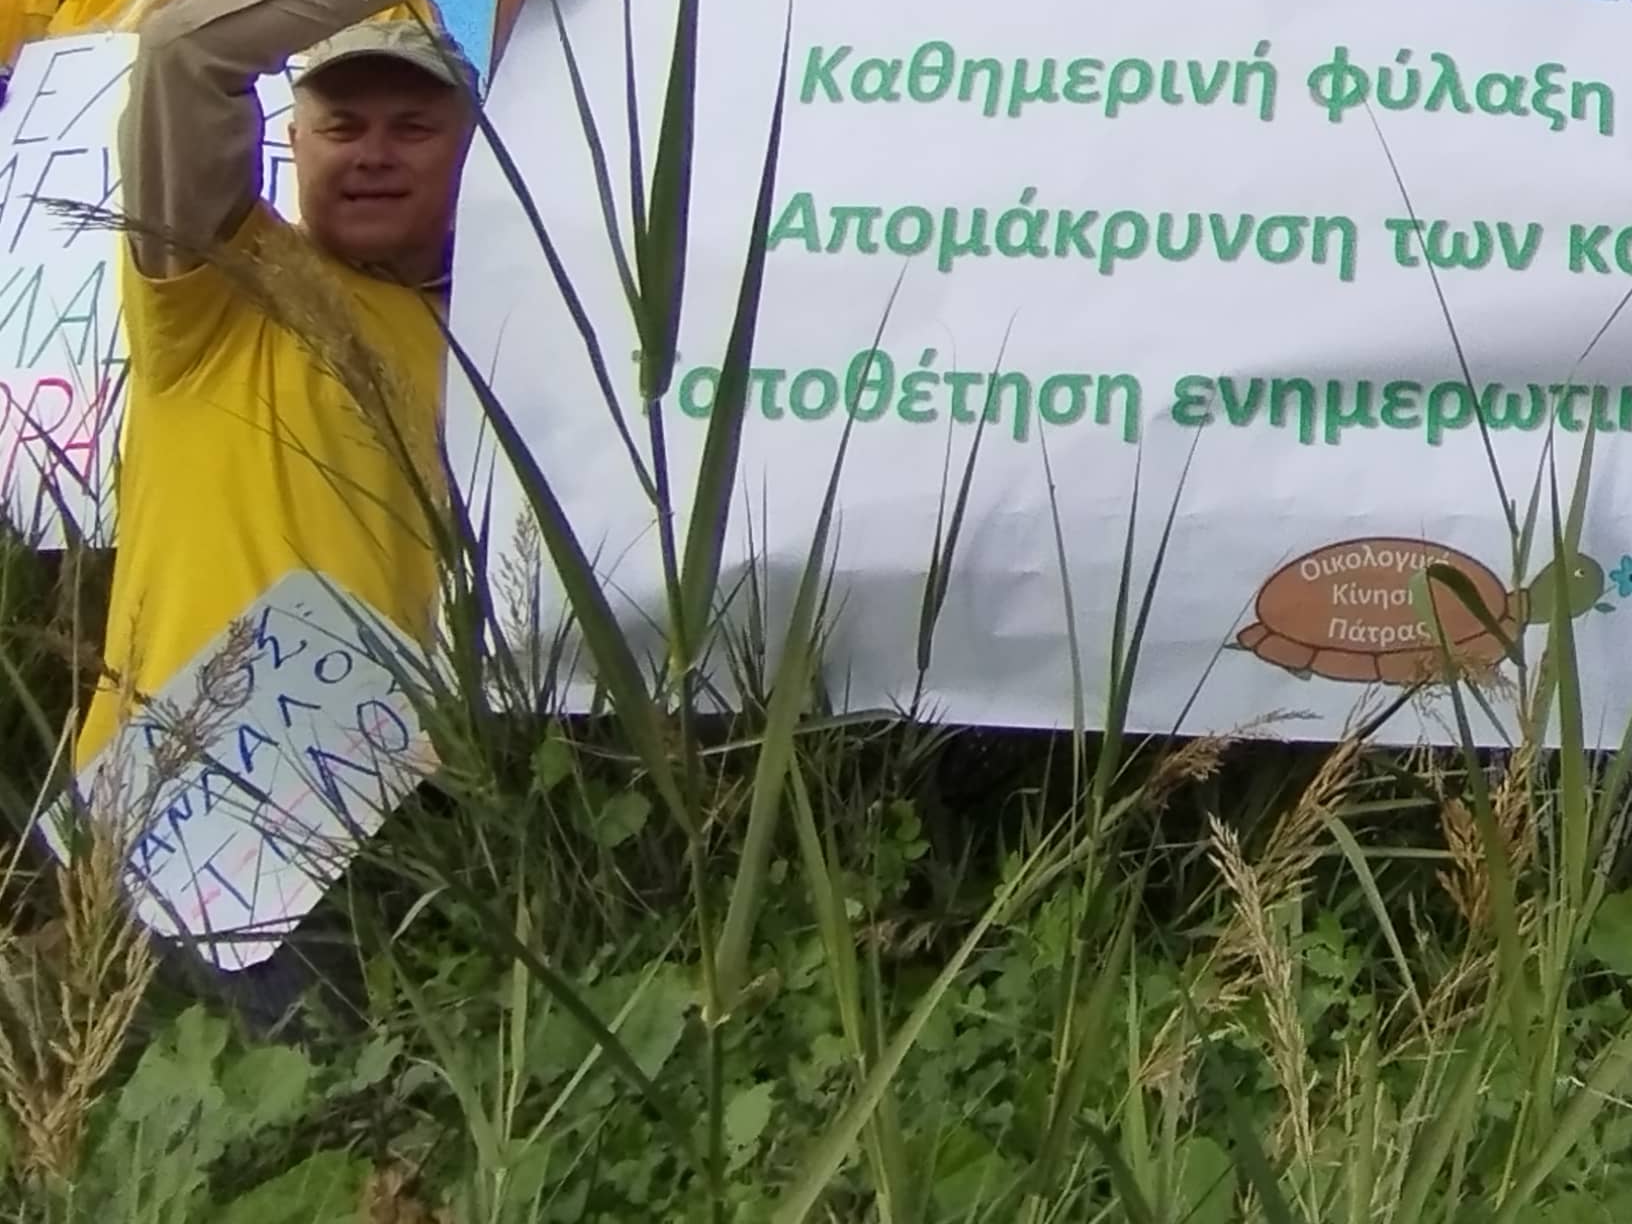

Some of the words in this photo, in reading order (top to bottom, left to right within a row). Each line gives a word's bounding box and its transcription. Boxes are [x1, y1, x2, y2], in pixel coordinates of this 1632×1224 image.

[800, 40, 1280, 122] Καθημερινή
[1305, 45, 1616, 138] φύλαξη
[765, 187, 1358, 282] Απομάκρυνση
[1384, 216, 1543, 272] των
[630, 346, 1142, 445] οποθέτηση
[1327, 616, 1432, 648] Πάτρας
